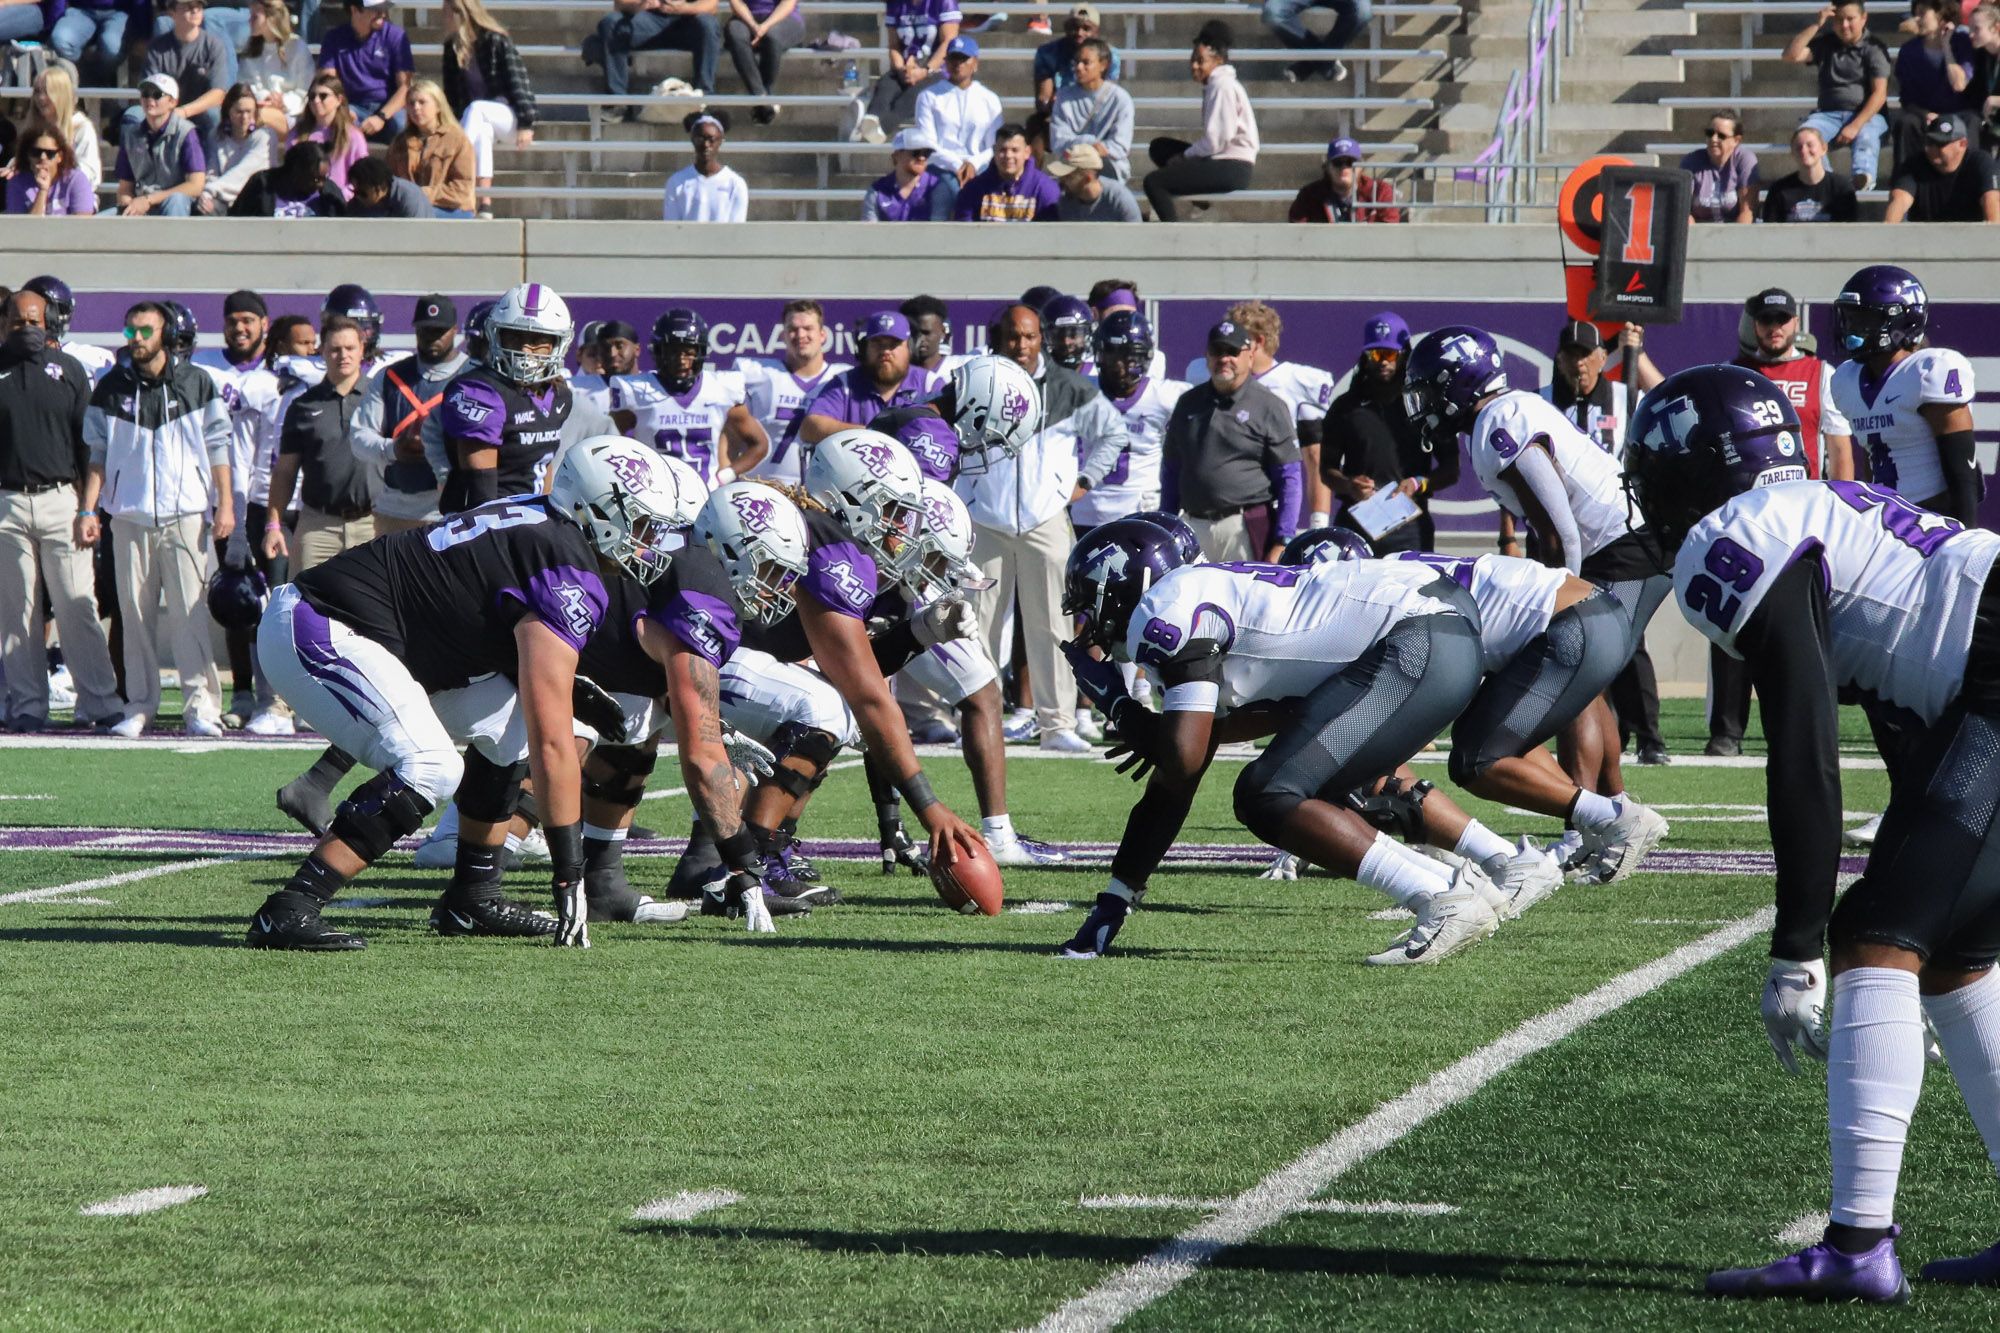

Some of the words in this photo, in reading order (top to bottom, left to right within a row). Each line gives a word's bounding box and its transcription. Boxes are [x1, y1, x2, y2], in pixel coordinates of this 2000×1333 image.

[1622, 182, 1655, 265] 1
[707, 322, 787, 355] CAA
[1944, 368, 1963, 398] 4
[449, 391, 489, 422] ACU
[514, 410, 536, 424] WAC
[659, 414, 709, 425] TARLETON
[1753, 399, 1785, 427] 29
[1852, 413, 1895, 432] TARLETON
[775, 406, 806, 464] 7
[910, 434, 950, 471] ACU
[1489, 427, 1518, 459] 9
[606, 456, 646, 495] ACU
[853, 443, 891, 479] ACU
[1761, 469, 1804, 485] TARLETON
[732, 496, 770, 534] ACU
[828, 560, 875, 608] ACU
[1684, 536, 1764, 634] 29
[557, 583, 592, 638] ACU
[686, 608, 723, 657] ACU
